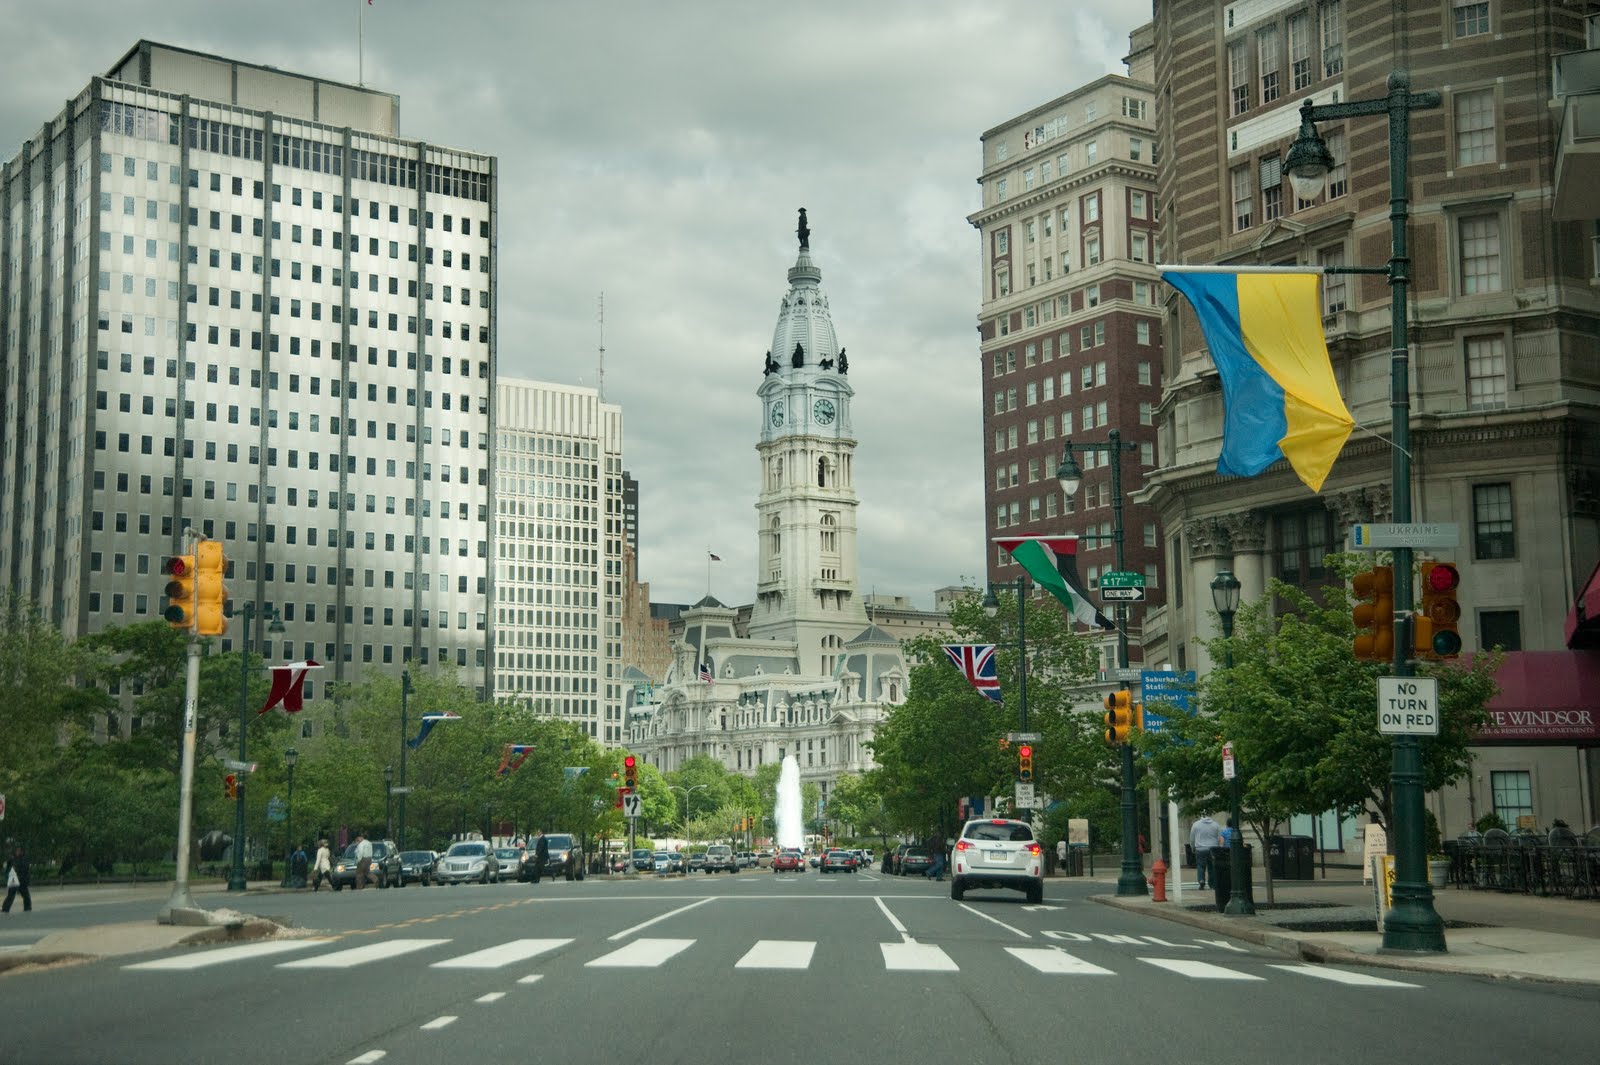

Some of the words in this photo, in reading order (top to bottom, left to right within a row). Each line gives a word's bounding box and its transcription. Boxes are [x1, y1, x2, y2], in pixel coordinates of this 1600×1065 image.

[1388, 526, 1439, 535] UKRAINE
[1110, 577, 1128, 586] 17TH
[1398, 684, 1416, 695] NO
[1388, 698, 1427, 710] TURN
[1382, 714, 1401, 725] ON
[1406, 714, 1434, 726] RED
[1508, 710, 1594, 726] WINDSOR
